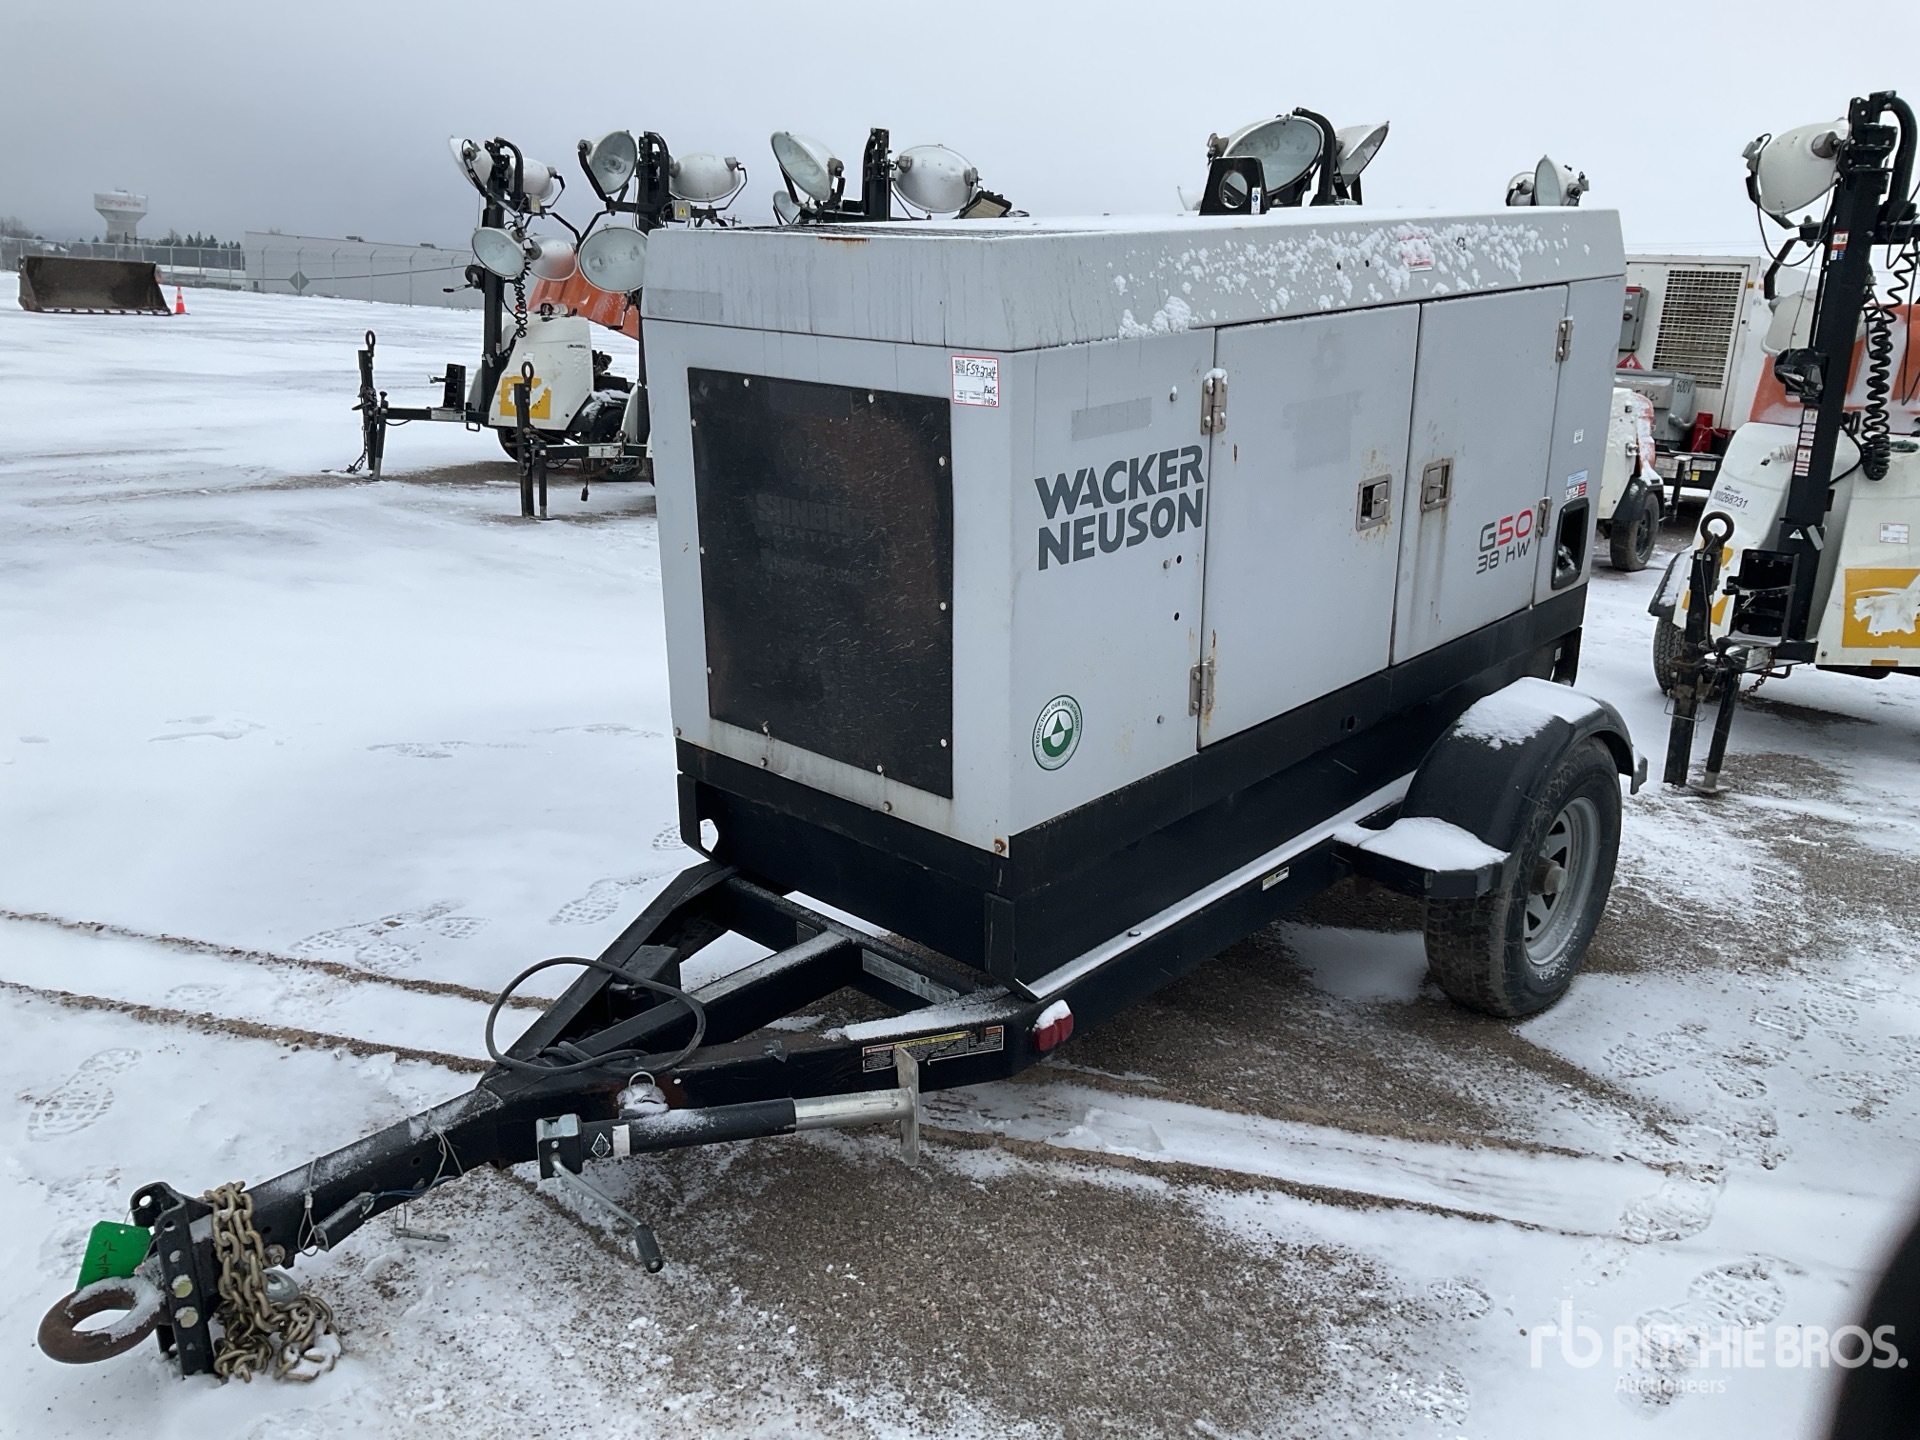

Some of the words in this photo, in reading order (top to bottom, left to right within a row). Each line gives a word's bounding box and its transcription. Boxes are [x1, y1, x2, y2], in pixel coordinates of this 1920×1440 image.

[1034, 444, 1205, 520] WACKER
[1038, 488, 1204, 571] NEUSON
[1479, 509, 1533, 553] G50
[1476, 550, 1500, 574] 38
